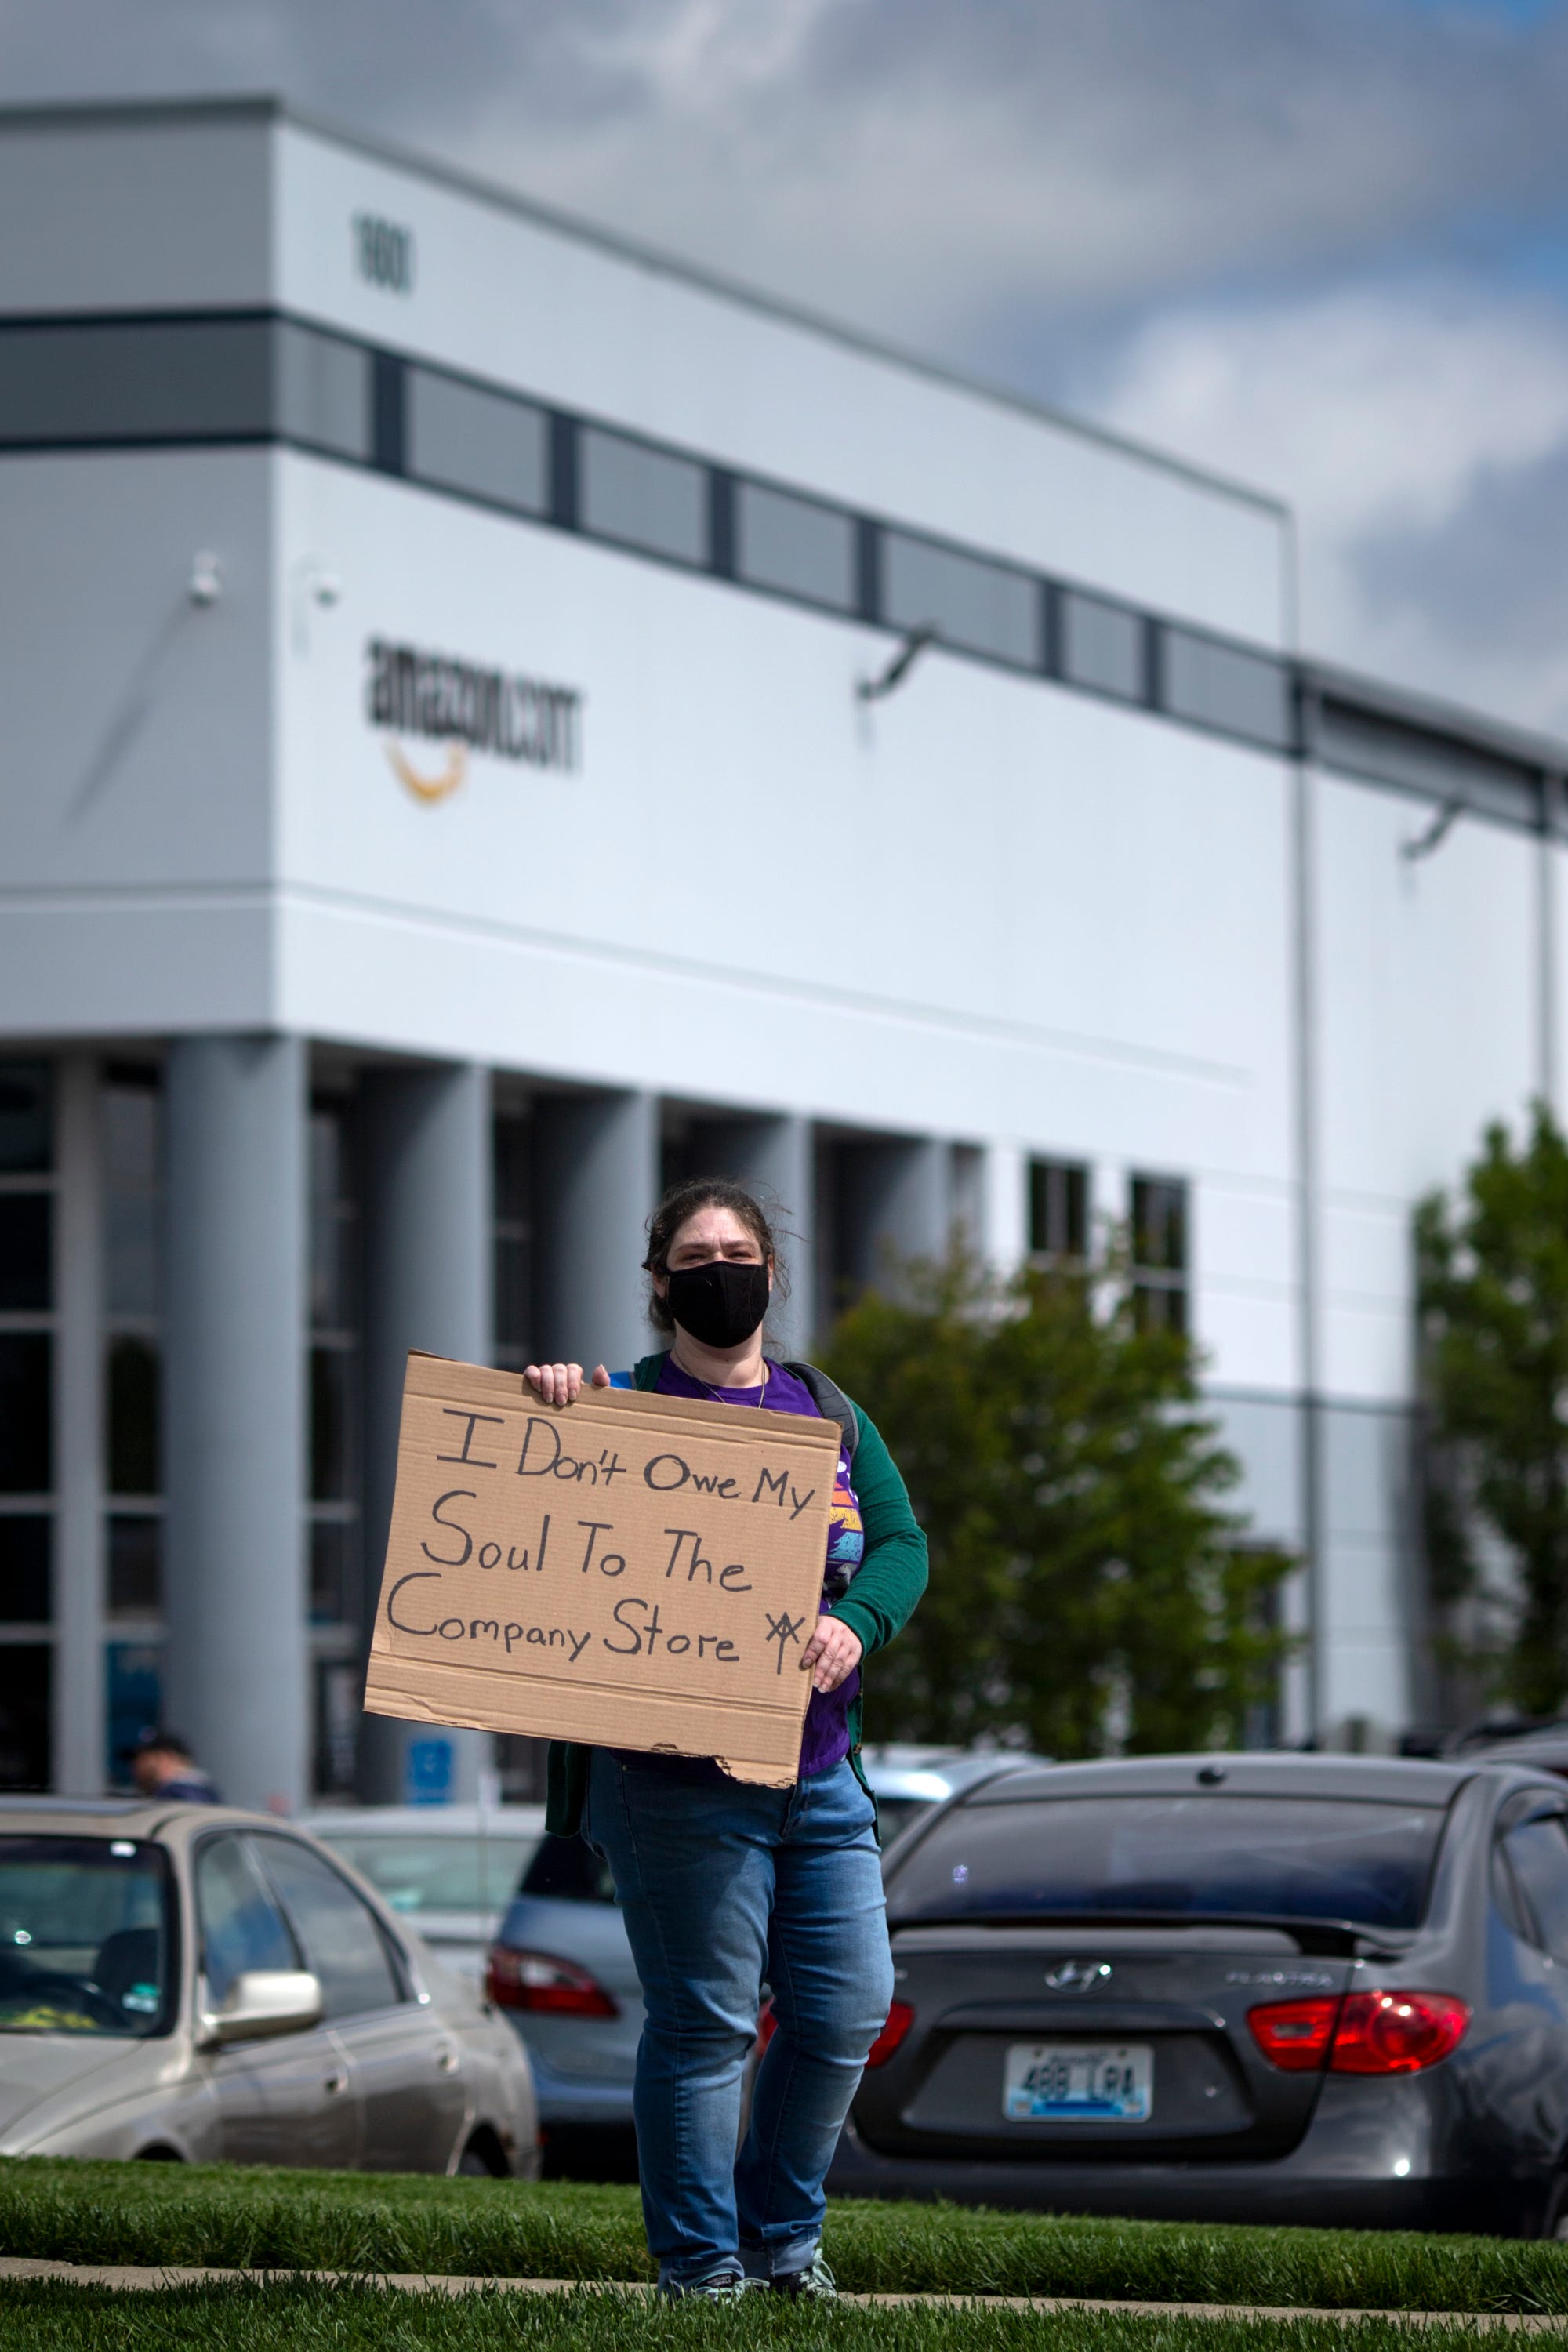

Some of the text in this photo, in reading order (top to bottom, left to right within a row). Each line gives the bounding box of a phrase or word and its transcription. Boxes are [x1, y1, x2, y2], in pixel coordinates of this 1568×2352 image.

[437, 1408, 815, 1520] I Don't Owe My
[420, 1490, 753, 1592] Soul To The
[387, 1572, 740, 1663] Company Store
